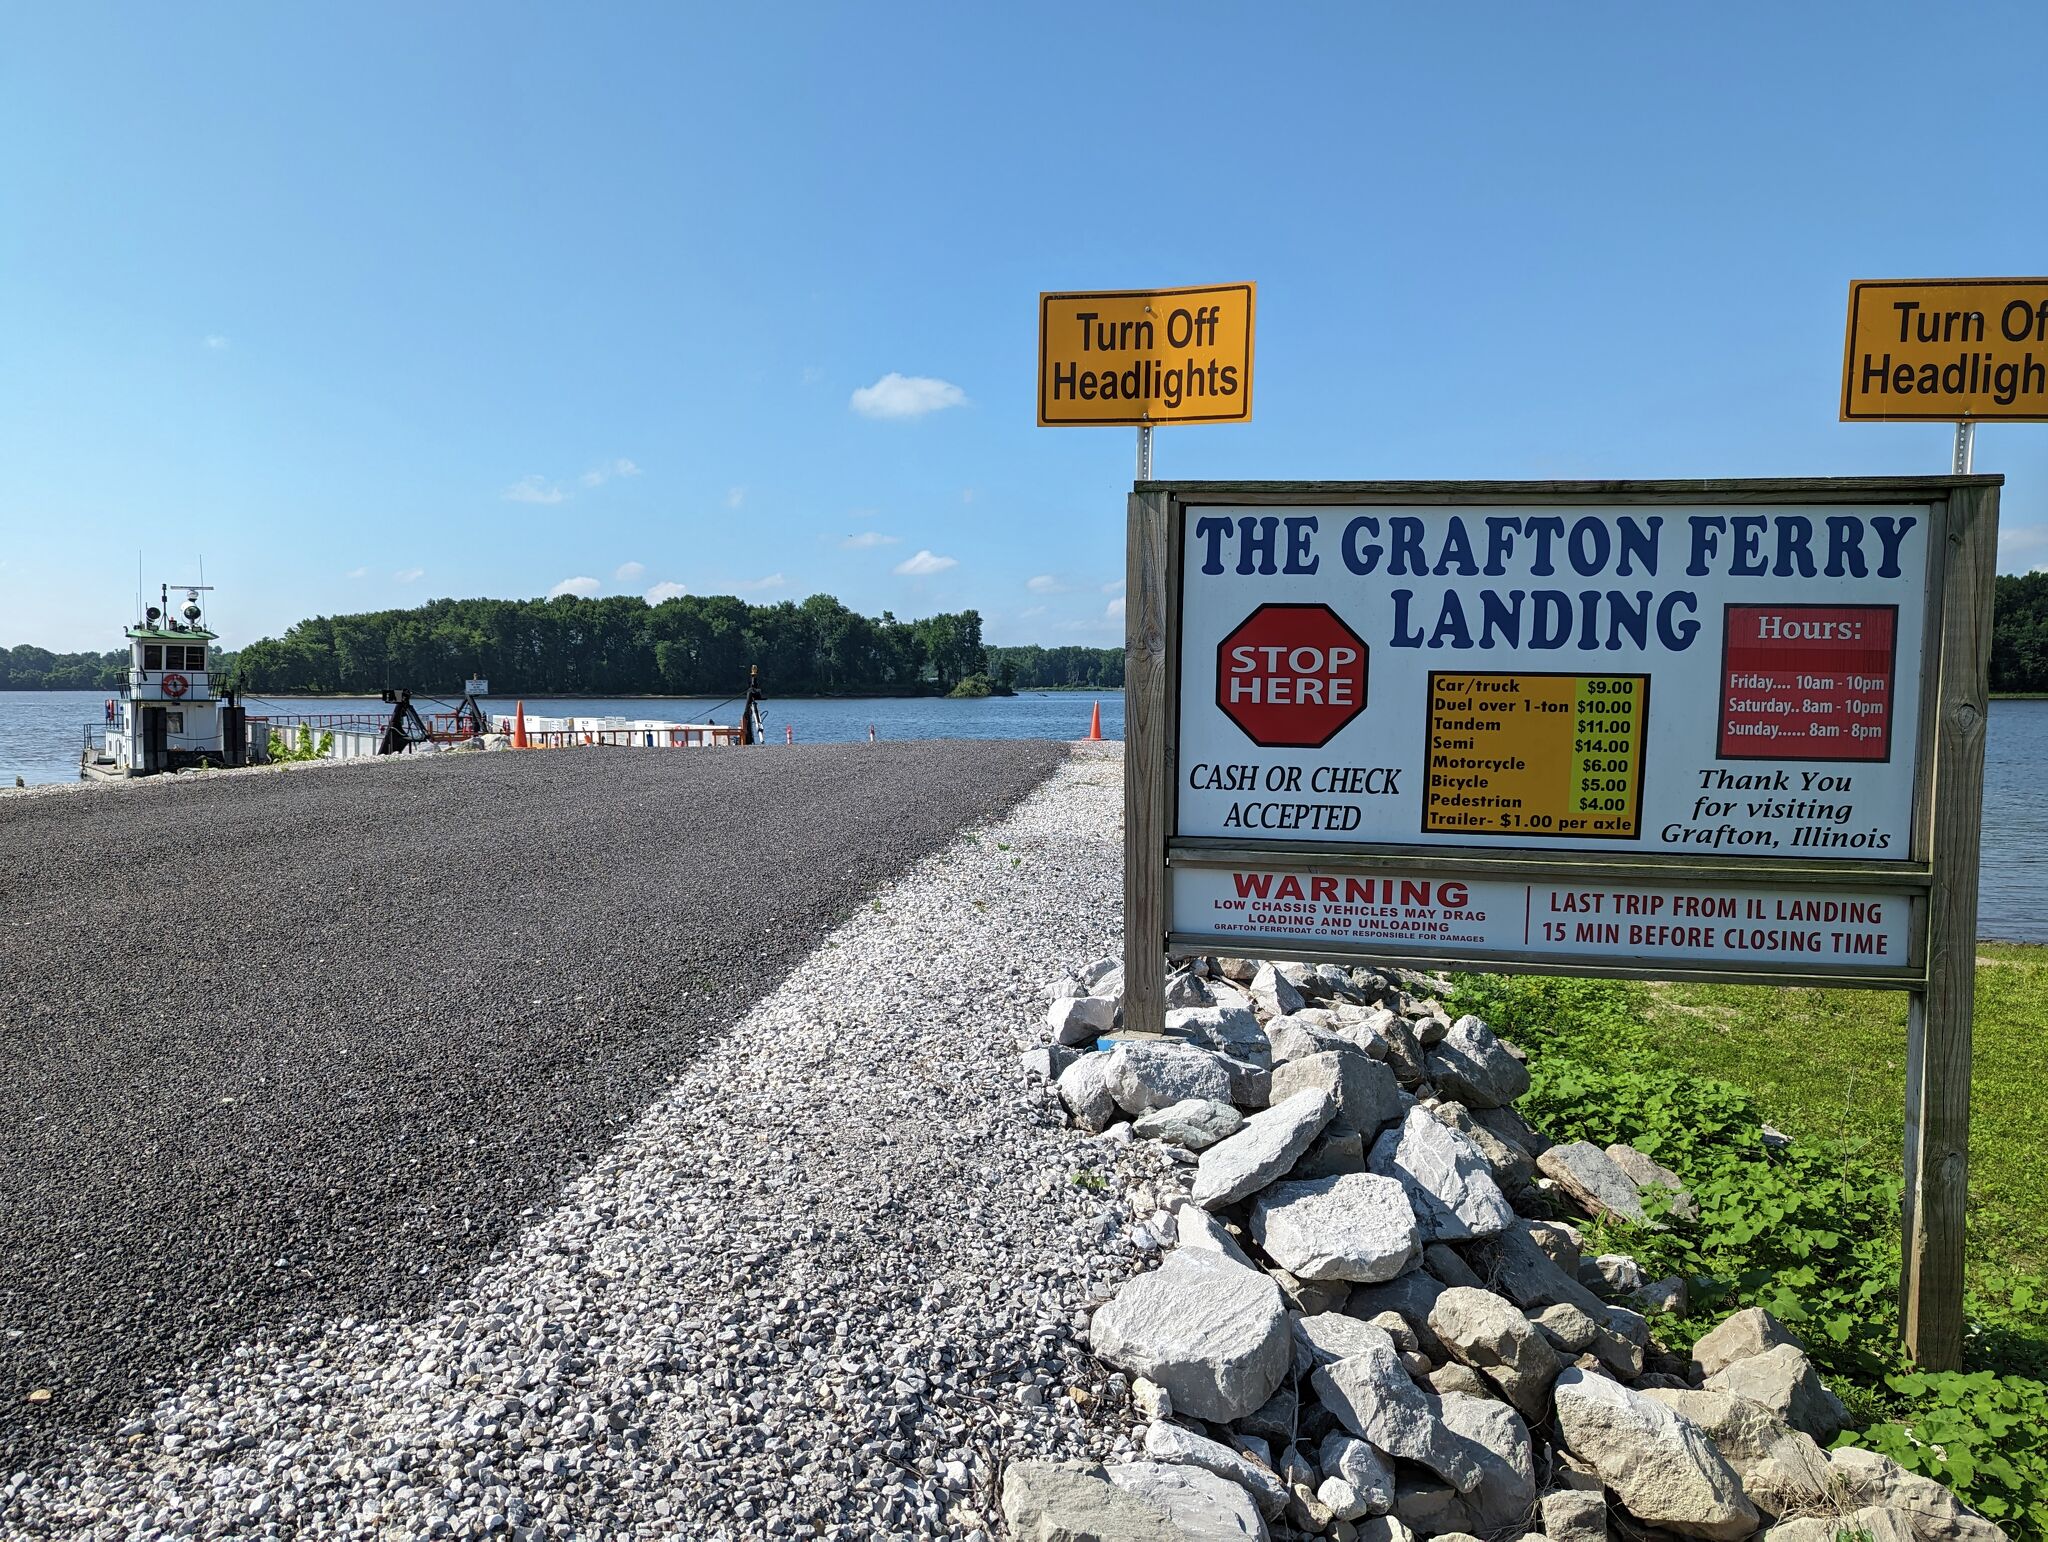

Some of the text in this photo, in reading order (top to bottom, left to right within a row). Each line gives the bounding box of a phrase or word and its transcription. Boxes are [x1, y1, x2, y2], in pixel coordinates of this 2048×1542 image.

[1077, 306, 1220, 351] Turn Off
[1894, 300, 2048, 342] Turn Of
[1054, 358, 1237, 408] Headlights
[1862, 353, 2047, 405] Headligh
[1196, 516, 1917, 578] THE GRAFTON FERRY
[1389, 589, 1701, 651] LANDING
[1758, 617, 1862, 639] Hours:
[1231, 646, 1356, 673] STOP
[1230, 678, 1352, 705] HERE
[1436, 679, 1632, 694] Car/truck $9.00
[1796, 675, 1833, 689] 10am
[1847, 676, 1884, 693] 10pm
[1435, 698, 1631, 714] Duel over 1-ton $10.00
[1802, 699, 1833, 713] 8am
[1845, 700, 1883, 717] 10pm
[1435, 717, 1630, 733] Tandem $11.00
[1810, 723, 1839, 737] 8am
[1852, 724, 1881, 740] 8pm
[1433, 737, 1629, 753] Semi $14.00
[1433, 756, 1627, 772] Motorcycle $6.00
[1190, 764, 1402, 794] CASH OR CHECK
[1432, 775, 1626, 792] Bicycle $5.00
[1699, 769, 1852, 791] Thank You
[1431, 794, 1625, 811] Pedestrian $4.00
[1692, 797, 1852, 824] for visiting
[1224, 803, 1361, 830] ACCEPTED
[1500, 813, 1551, 828] $1.00
[1559, 817, 1587, 831] per
[1594, 817, 1631, 830] axle
[1661, 824, 1890, 849] Grafton, Illinois
[1233, 874, 1469, 908] WARNING
[1214, 900, 1486, 921] LOW CHASSIS VEHICLES MAY DRAG
[1551, 892, 1882, 924] LAST TRIP FROM IL LANDING
[1248, 913, 1449, 932] LOADING AND UNLOADING
[1260, 925, 1312, 935] FERRYBOAT
[1352, 930, 1415, 940] RESPONSIBLE
[1439, 934, 1485, 942] DAMAGES
[1543, 922, 1888, 955] 15 MIN BEFORE CLOSING TIME
